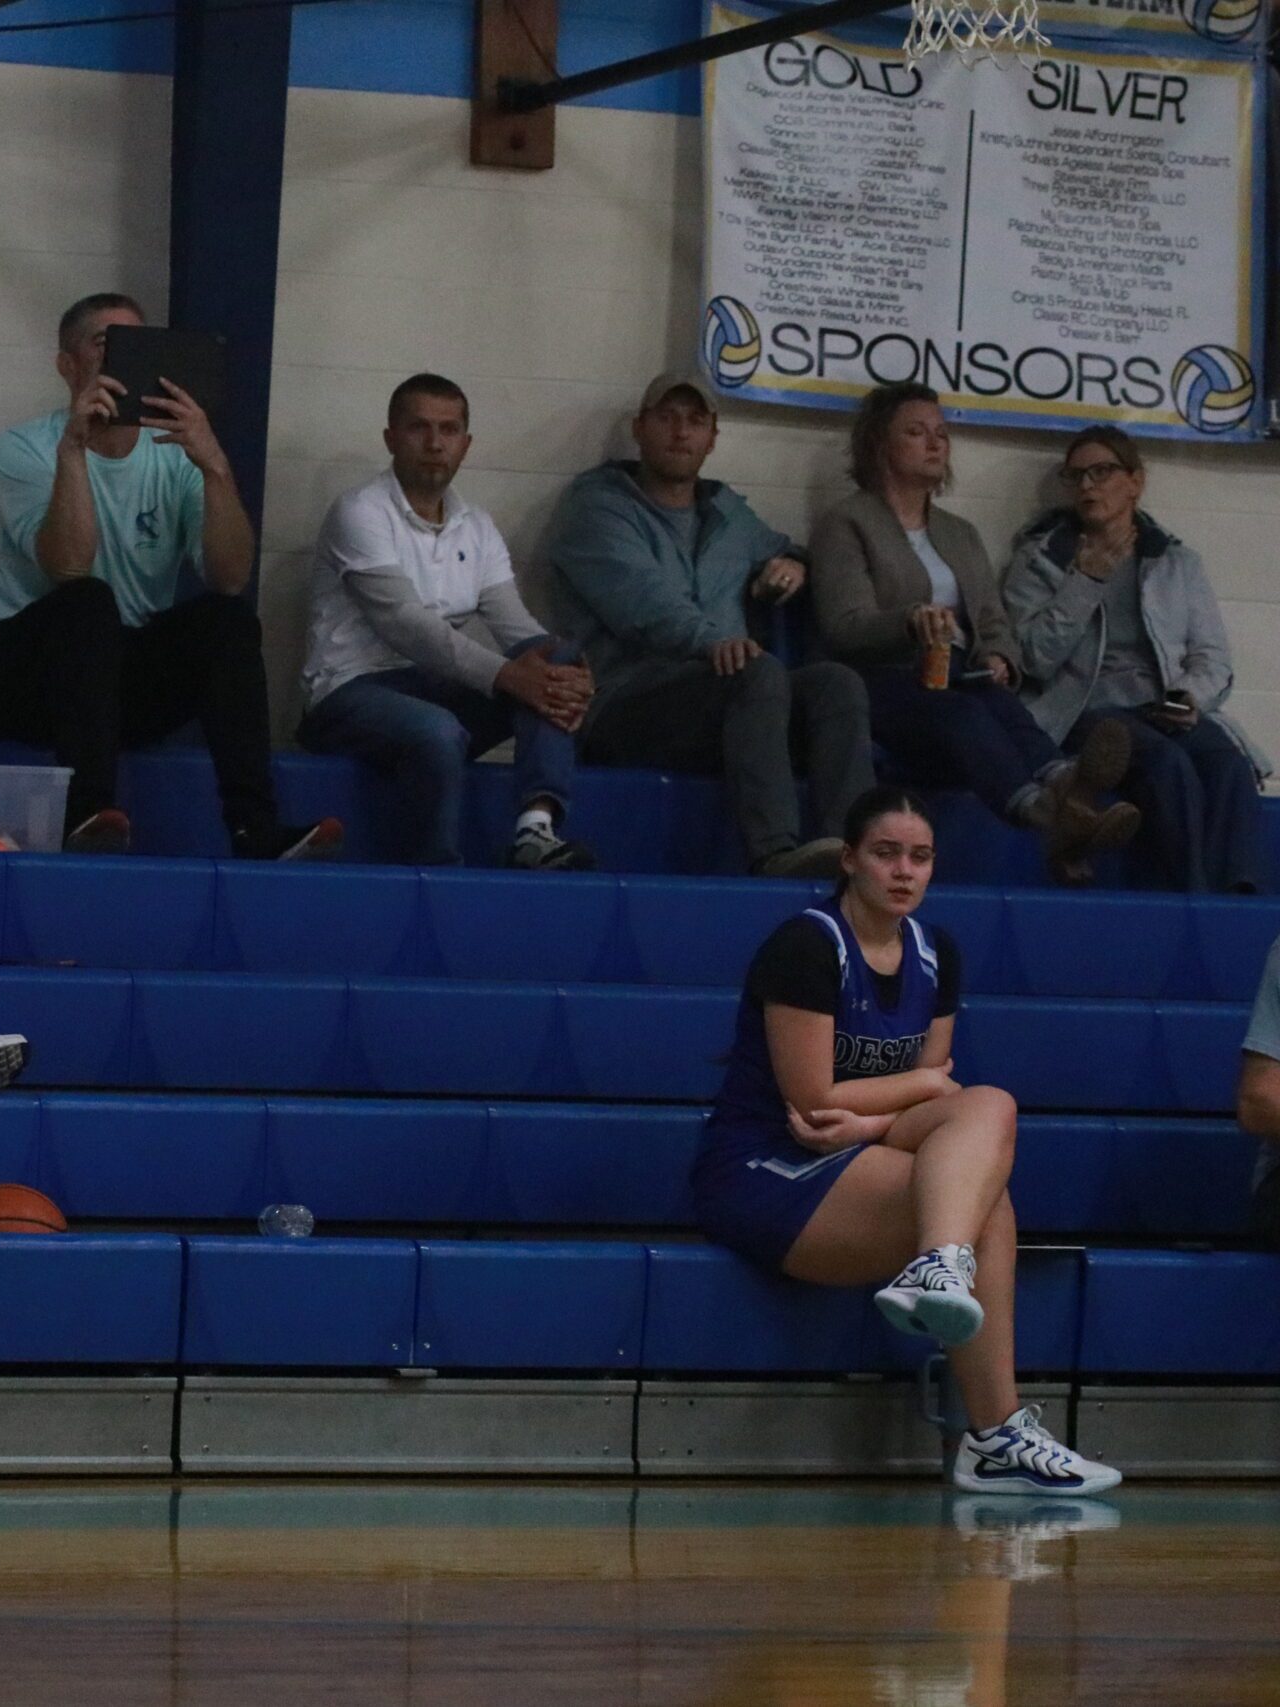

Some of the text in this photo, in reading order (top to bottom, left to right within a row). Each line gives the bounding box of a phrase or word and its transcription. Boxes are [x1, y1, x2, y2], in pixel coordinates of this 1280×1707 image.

[764, 38, 922, 98] GOLD
[1027, 60, 1188, 124] SILVER
[768, 323, 1164, 408] SPONSORS
